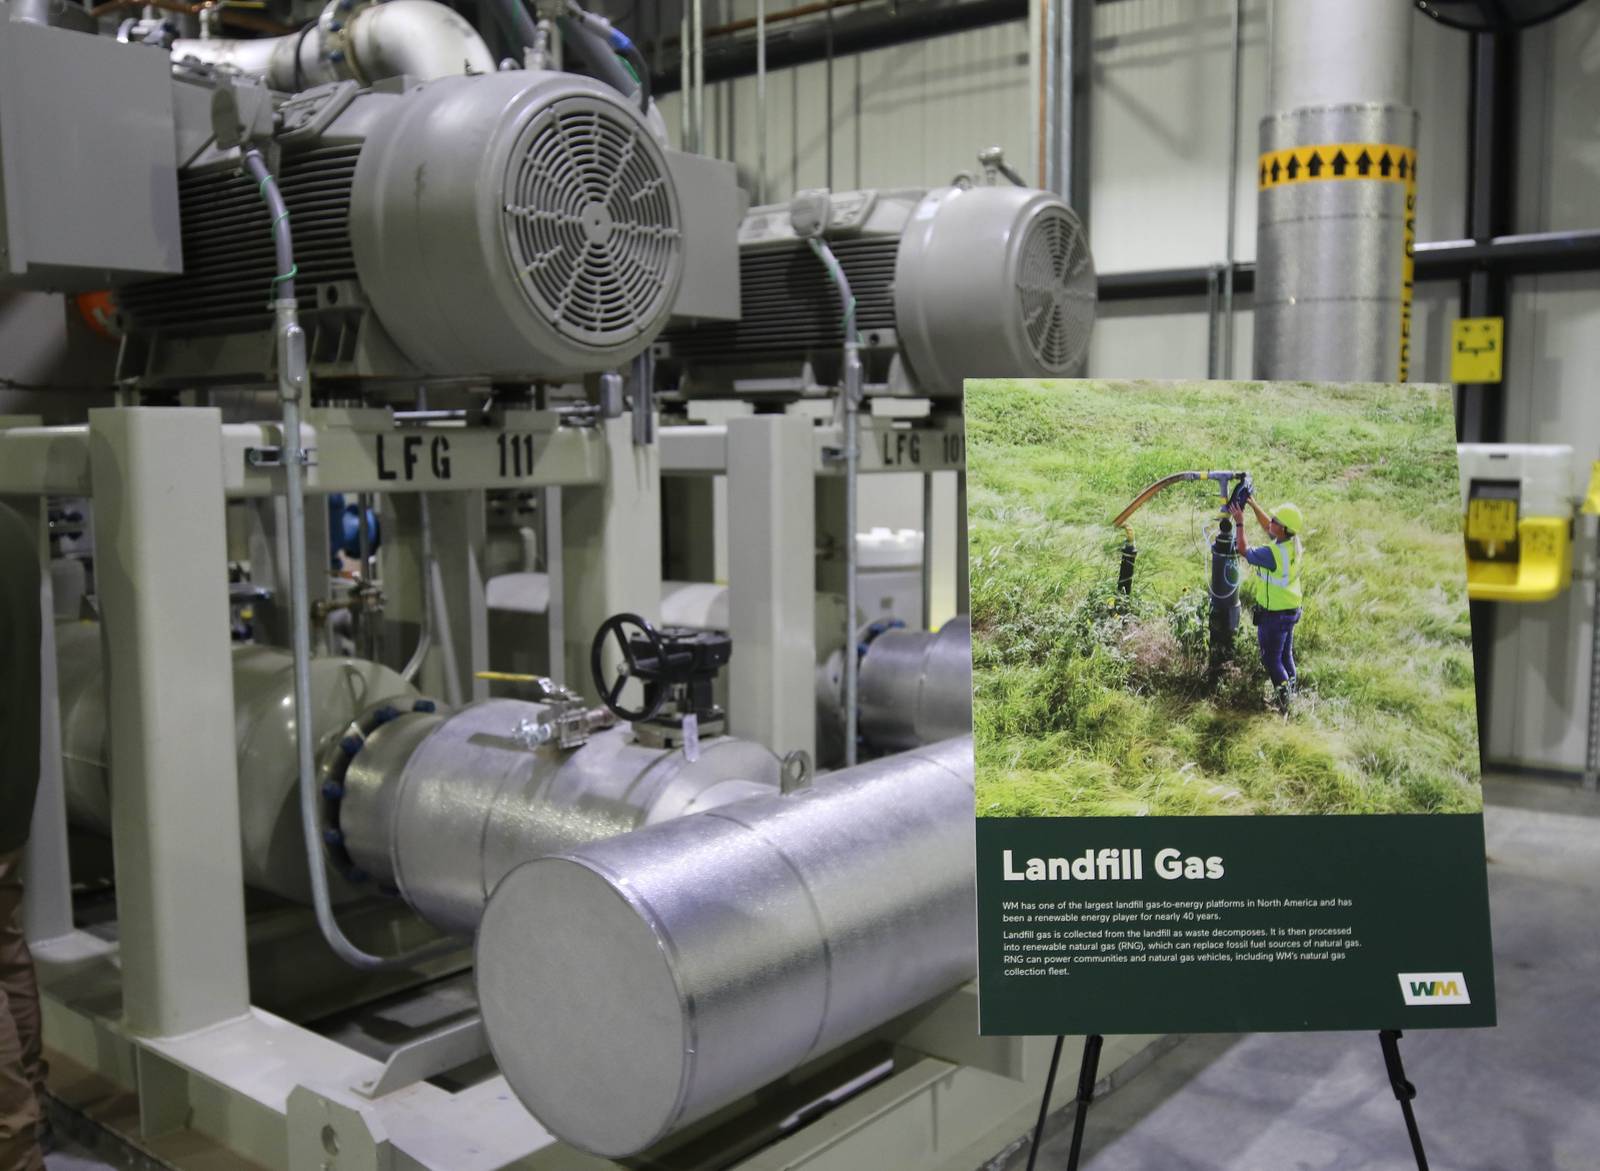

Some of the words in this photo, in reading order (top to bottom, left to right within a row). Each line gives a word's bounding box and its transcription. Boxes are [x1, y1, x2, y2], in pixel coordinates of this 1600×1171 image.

[883, 432, 920, 464] LFG
[376, 434, 451, 480] LFG
[497, 433, 534, 477] 111
[1003, 848, 1143, 881] Landfill
[1154, 848, 1225, 880] Gas
[1002, 900, 1019, 910] WM
[1021, 900, 1036, 910] has
[1038, 902, 1055, 910] one
[1057, 900, 1066, 909] of
[1068, 900, 1083, 909] the
[1085, 899, 1114, 911] largest
[1115, 899, 1144, 909] landfill
[1145, 898, 1204, 911] gas-to-energy
[1206, 898, 1245, 910] platforms
[1247, 898, 1255, 907] in
[1257, 898, 1281, 907] North
[1283, 897, 1318, 907] America
[1320, 897, 1336, 907] and
[1338, 897, 1353, 906] has
[1003, 913, 1025, 922] been
[1027, 914, 1032, 922] a
[1034, 912, 1079, 922] renewable
[1081, 914, 1110, 924] energy
[1112, 911, 1138, 923] player
[1140, 911, 1152, 921] for
[1155, 911, 1181, 923] nearly
[1183, 911, 1194, 920] 40
[1196, 913, 1221, 922] years.
[1003, 929, 1034, 939] Landfill
[1036, 931, 1051, 941] gas
[1054, 929, 1061, 939] is
[1063, 929, 1103, 939] collected
[1105, 928, 1125, 938] from
[1127, 928, 1141, 938] the
[1143, 928, 1171, 938] landfill
[1185, 927, 1210, 937] waste
[1212, 927, 1268, 939] decomposes.
[1270, 927, 1276, 936] It
[1278, 927, 1285, 936] is
[1287, 926, 1306, 936] then
[1308, 926, 1352, 938] processed
[1003, 942, 1020, 951] into
[1022, 941, 1067, 951] renewable
[1069, 941, 1099, 951] natural
[1100, 943, 1115, 953] gas
[1118, 940, 1145, 952] (RNG),
[1148, 940, 1174, 950] which
[1175, 942, 1191, 950] can
[1193, 940, 1224, 952] replace
[1226, 939, 1249, 949] fossil
[1250, 939, 1266, 949] fuel
[1303, 939, 1312, 948] of
[1314, 938, 1343, 948] natural
[1345, 940, 1362, 950] gas.
[1004, 954, 1024, 964] RNG
[1026, 956, 1042, 964] can
[1044, 956, 1071, 966] power
[1073, 953, 1128, 963] communities
[1130, 953, 1146, 962] and
[1149, 953, 1178, 962] natural
[1180, 954, 1195, 964] gas
[1197, 952, 1233, 964] vehicles,
[1235, 951, 1274, 963] including
[1275, 951, 1298, 961] WM's
[1300, 951, 1329, 961] natural
[1330, 953, 1346, 962] gas
[1004, 966, 1046, 976] collection
[1048, 966, 1070, 975] fleet.
[1410, 981, 1459, 996] WM
